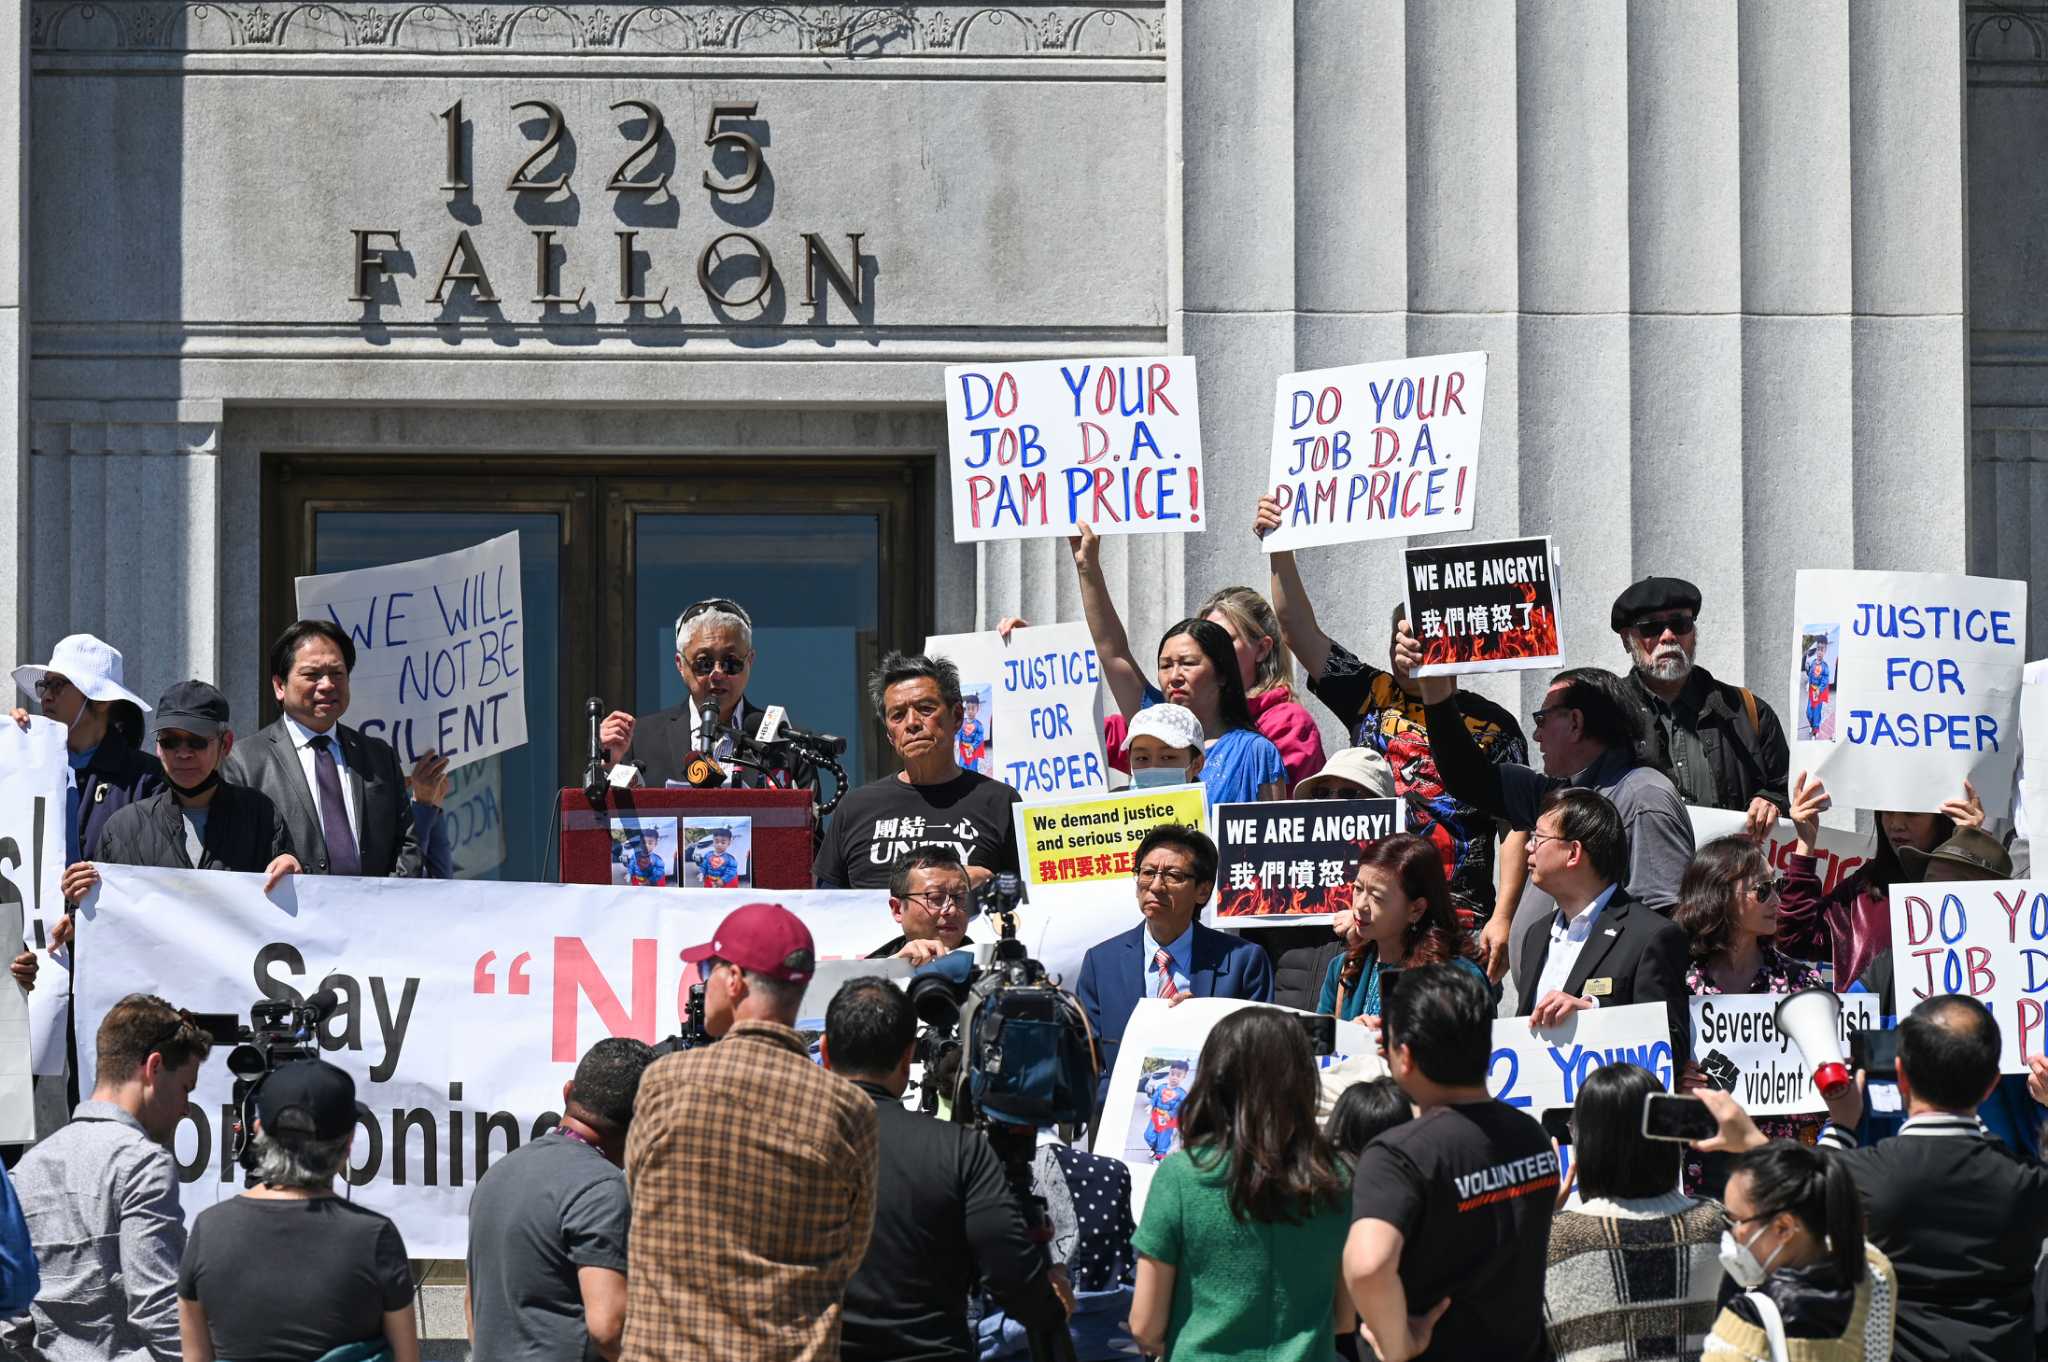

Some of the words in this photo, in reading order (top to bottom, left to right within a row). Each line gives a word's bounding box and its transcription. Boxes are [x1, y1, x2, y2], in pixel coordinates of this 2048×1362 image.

[439, 99, 764, 195] 1225
[348, 228, 866, 306] FALLON
[959, 372, 1019, 420] DO
[1060, 363, 1179, 417] YOUR
[1289, 386, 1342, 430] DO
[1369, 371, 1466, 423] YOUR
[964, 424, 1047, 468] JOB
[1077, 421, 1181, 465] D.A.
[1288, 430, 1352, 476] JOB
[1368, 423, 1452, 468] D.A.
[967, 472, 1048, 528] PAM
[1060, 466, 1200, 523] PRICE!
[1275, 476, 1338, 528] PAM
[1346, 466, 1468, 523] PRICE!
[1412, 564, 1439, 592] WE
[1444, 561, 1477, 589] ARE
[1482, 555, 1545, 586] ANGRY!
[328, 592, 414, 649] WE
[433, 565, 513, 636] WILL
[1853, 603, 2016, 645] JUSTICE
[399, 639, 472, 705] NOT
[478, 620, 519, 688] BE
[1004, 649, 1099, 692] JUSTICE
[1887, 657, 1966, 694] FOR
[1030, 703, 1073, 740] FOR
[1847, 710, 1999, 752] JASPER
[1004, 751, 1104, 793] JASPER
[1033, 814, 1057, 831] We
[1061, 807, 1120, 829] demand
[1123, 804, 1175, 825] justice
[1036, 834, 1064, 852] and
[1068, 826, 1123, 848] serious
[1226, 818, 1258, 845] WE
[1263, 816, 1306, 844] ARE
[1311, 813, 1391, 843] ANGRY!
[869, 840, 977, 866] UNY
[1039, 850, 1139, 882] 我們要求正
[1229, 858, 1359, 890] 我們憤怒
[1905, 893, 1968, 946] DO
[1911, 946, 1997, 1001] JOB
[253, 942, 421, 1083] Say
[1487, 1047, 1532, 1107] 2
[1744, 1059, 1804, 1105] violent
[1454, 1150, 1558, 1200] VOLUNTEER
